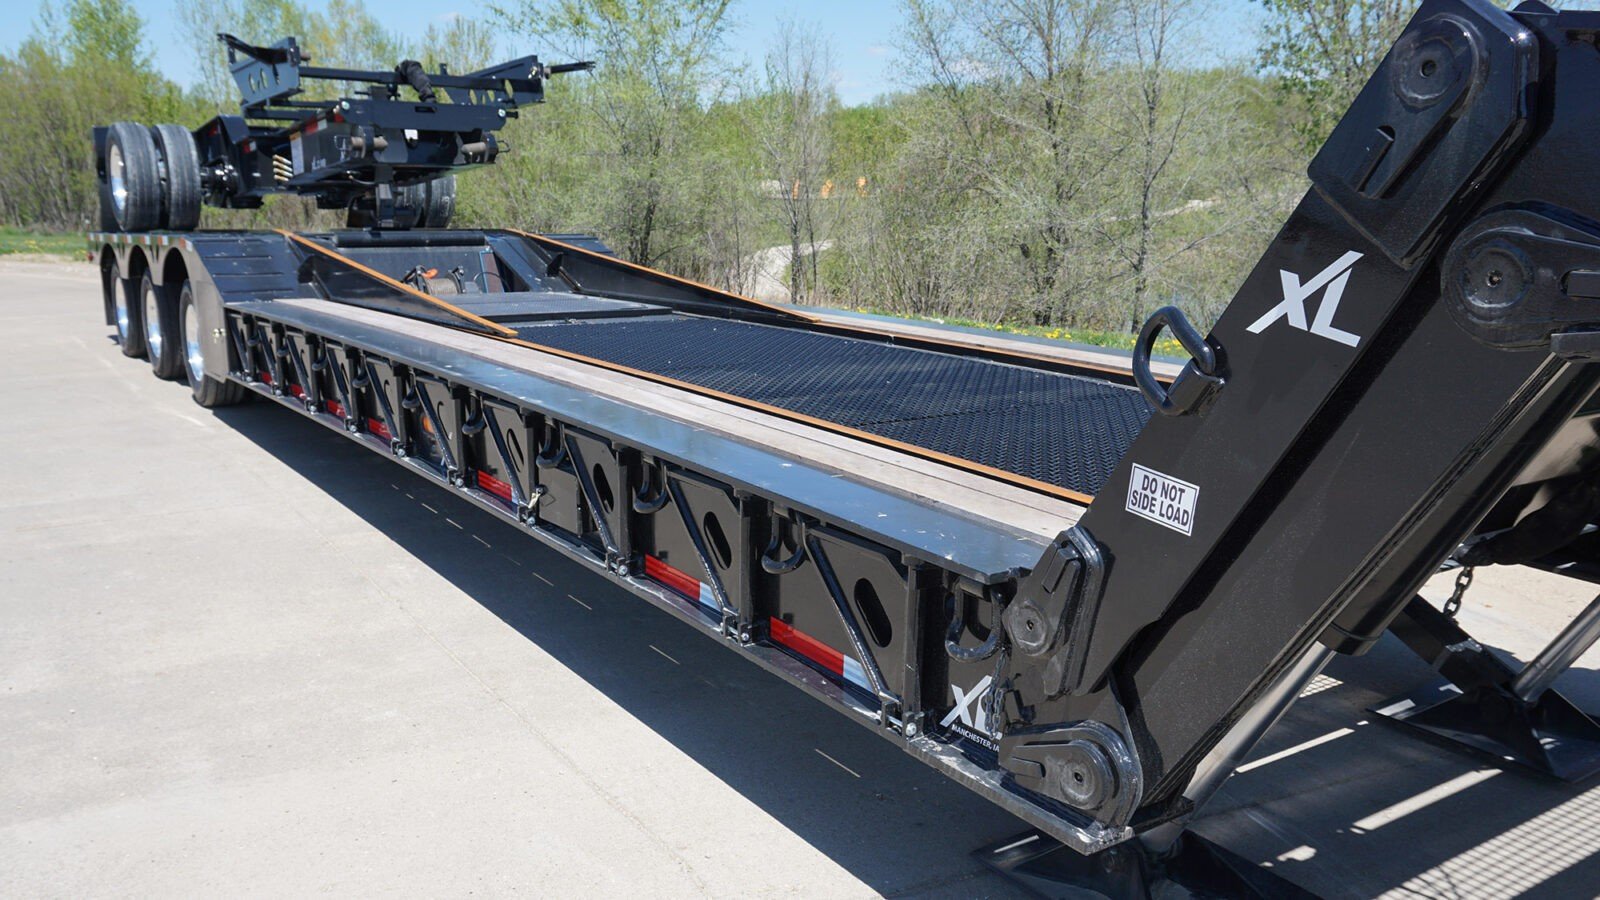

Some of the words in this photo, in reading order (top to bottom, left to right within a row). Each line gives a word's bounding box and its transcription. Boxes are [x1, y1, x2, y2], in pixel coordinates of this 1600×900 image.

[1245, 250, 1365, 348] XL
[1142, 474, 1158, 495] DO
[1160, 481, 1186, 505] NOT
[1131, 490, 1157, 514] SIDE
[1159, 500, 1190, 527] LOAD
[951, 723, 993, 750] MANCHESTER,
